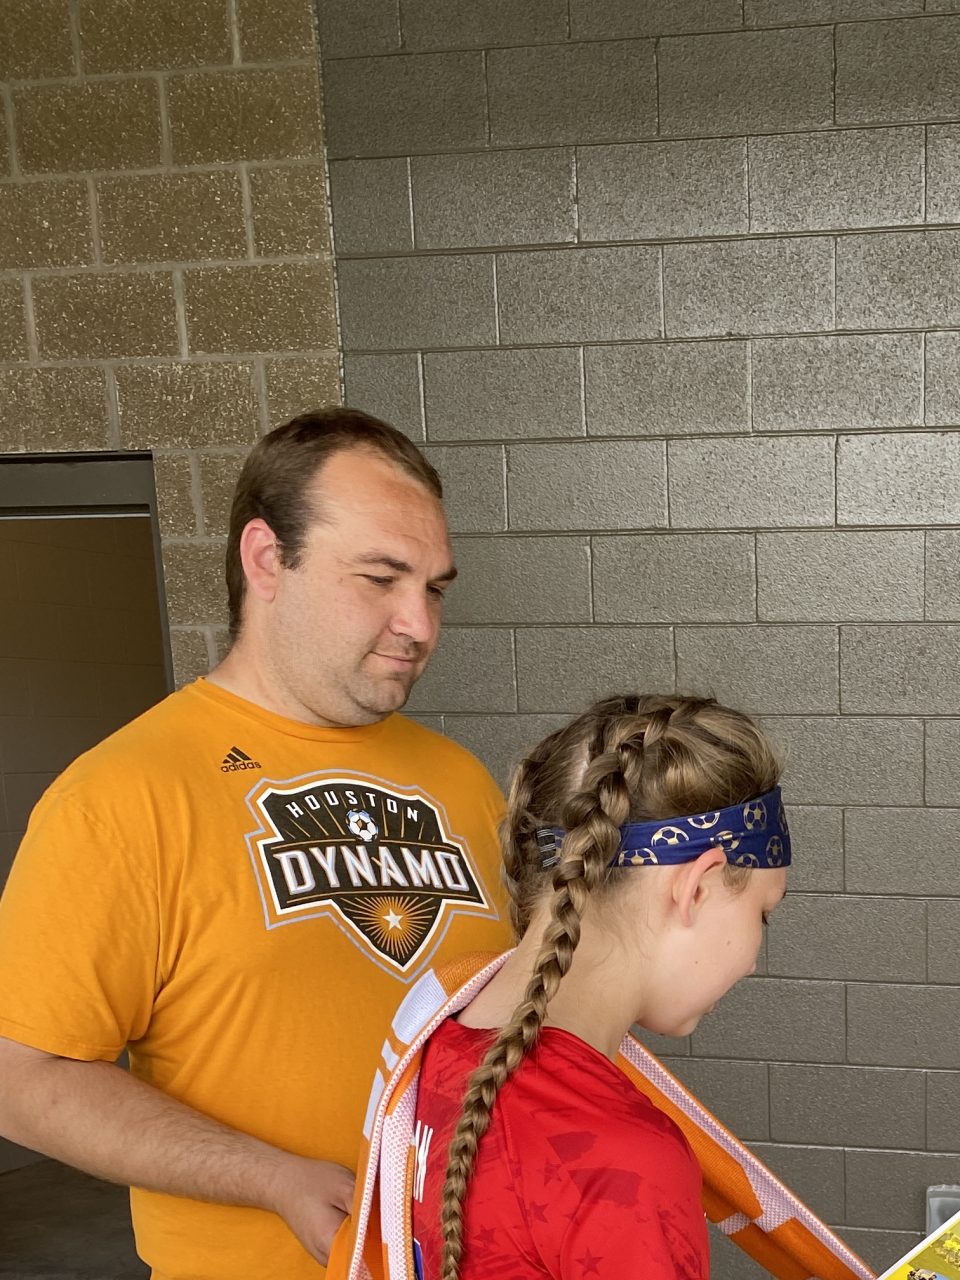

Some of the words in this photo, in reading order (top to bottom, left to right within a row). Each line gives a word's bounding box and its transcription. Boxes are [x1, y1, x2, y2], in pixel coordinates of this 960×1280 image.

[221, 761, 262, 773] adidas
[285, 790, 418, 822] HOUSTON
[272, 845, 470, 896] DYNAMO
